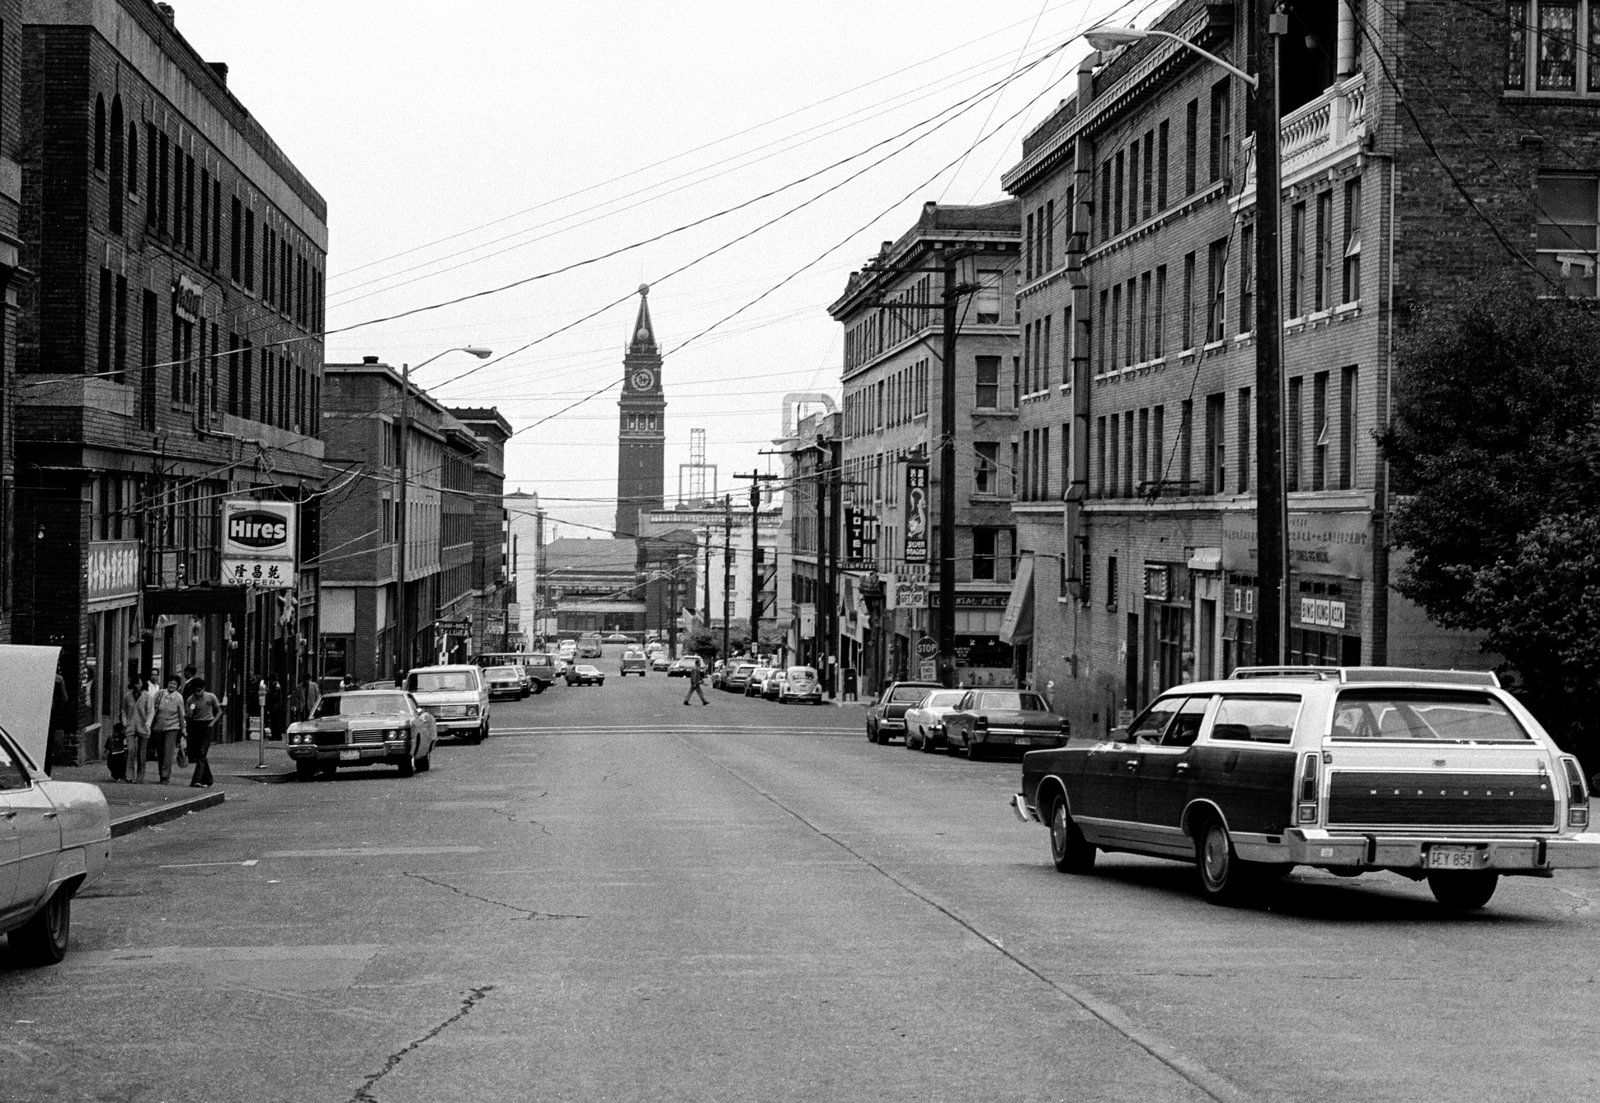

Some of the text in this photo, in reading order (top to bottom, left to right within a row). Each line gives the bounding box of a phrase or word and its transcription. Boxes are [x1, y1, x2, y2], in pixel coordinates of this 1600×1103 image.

[230, 516, 287, 539] Hires
[853, 504, 861, 558] HOTEL
[917, 644, 937, 653] STOP
